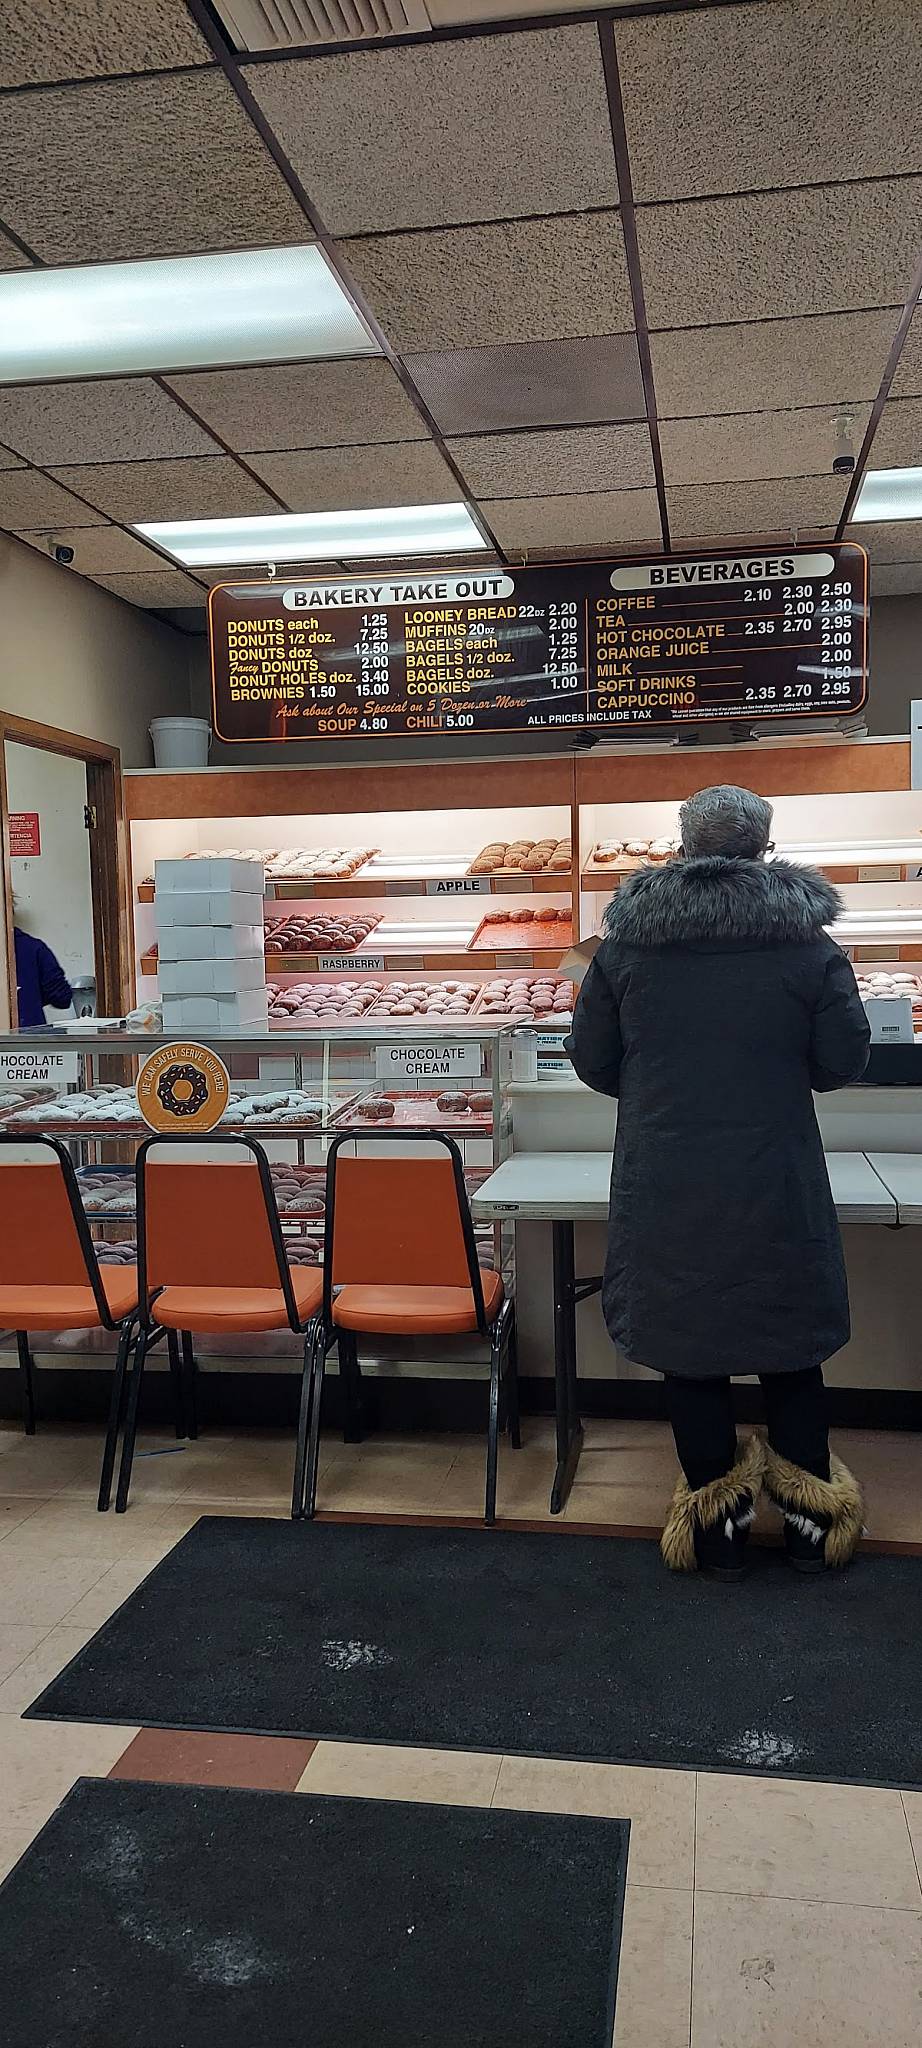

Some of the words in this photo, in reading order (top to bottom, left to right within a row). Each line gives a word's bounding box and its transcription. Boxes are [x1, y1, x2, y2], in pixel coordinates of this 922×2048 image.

[650, 559, 795, 585] BEVERAGES
[295, 587, 383, 606] BAKERY
[390, 584, 447, 601] TAKE
[456, 580, 502, 597] OUT
[596, 596, 655, 612] COFFEE
[744, 589, 771, 602] 2.10
[783, 585, 813, 599] 2.30
[821, 582, 851, 596] 2.50
[405, 609, 463, 624] LOONEY
[468, 607, 516, 620] BREAD
[549, 603, 577, 616] 2.20
[596, 615, 625, 628] TEA
[784, 601, 814, 615] 2.00
[821, 599, 852, 612] 2.30
[228, 619, 284, 633] DONUTS
[288, 618, 318, 630] each
[362, 614, 387, 626] 1.25
[405, 624, 466, 638] MUFFINS
[549, 617, 577, 630] 2.00
[596, 631, 627, 644] HOT
[632, 625, 725, 642] CHOCOLATE
[745, 621, 775, 634] 2.35
[783, 619, 812, 632] 2.70
[821, 616, 851, 629] 2.95
[228, 634, 284, 647] DONUTS
[289, 634, 305, 644] 1/2
[309, 633, 336, 643] doz.
[360, 628, 388, 640] 7.25
[405, 639, 463, 652] BAGELS
[466, 638, 497, 650] each
[549, 633, 577, 645] 1.25
[597, 645, 660, 660] ORANGE
[666, 642, 709, 656] JUICE
[822, 632, 851, 645] 2.00
[229, 647, 285, 661] DONUTS
[289, 647, 312, 658] doz
[354, 642, 388, 654] 12.50
[406, 654, 463, 667] BAGELS
[467, 654, 483, 664] 1/2
[487, 652, 515, 663] doz.
[549, 647, 577, 660] 7.25
[229, 662, 259, 675] Fancy
[262, 660, 318, 673] DONUTS
[362, 656, 388, 669] 2.00
[407, 668, 464, 682] BAGELS
[467, 668, 494, 679] doz.
[543, 662, 577, 675] 12.50
[597, 663, 632, 676] MILK
[821, 649, 851, 662] 2.00
[229, 675, 276, 687] DONUT
[281, 673, 326, 685] HOLES
[330, 672, 356, 683] doz.
[362, 671, 388, 683] 3.40
[407, 682, 470, 695] COOKIES
[551, 677, 578, 689] 1.00
[597, 679, 635, 693] SOFT
[640, 676, 695, 691] DRINKS
[823, 666, 851, 679] 1.50
[232, 687, 304, 700] BROWNIES
[310, 686, 336, 697] 1.50
[356, 683, 389, 696] 15.00
[598, 692, 695, 709] CAPPUCCINO
[745, 687, 776, 700] 2.35
[784, 684, 812, 698] 2.70
[822, 682, 850, 696] 2.95
[276, 706, 300, 718] Ask
[302, 706, 334, 716] about
[337, 704, 358, 715] Our
[363, 701, 407, 716] Special
[410, 703, 423, 712] on
[428, 700, 436, 711] 5
[441, 698, 476, 712] Dozen
[494, 696, 528, 709] More
[318, 719, 357, 731] SOUP
[360, 718, 388, 730] 4.80
[407, 716, 445, 728] CHILI
[446, 715, 474, 727] 5.00
[527, 714, 546, 725] ALL
[549, 713, 584, 723] PRICES
[587, 711, 629, 721] INCLUDE
[632, 710, 651, 719] TAX
[437, 881, 479, 891] APPLE
[323, 960, 380, 969] RASPBERRY
[154, 1049, 178, 1067] SAFELY
[181, 1048, 204, 1061] SERVE
[391, 1048, 464, 1060] CHOCOLATE
[7, 1069, 48, 1079] CREAM
[145, 1066, 156, 1081] CAN
[204, 1057, 217, 1072] YOU
[406, 1063, 449, 1074] CREAM
[142, 1083, 151, 1096] WE
